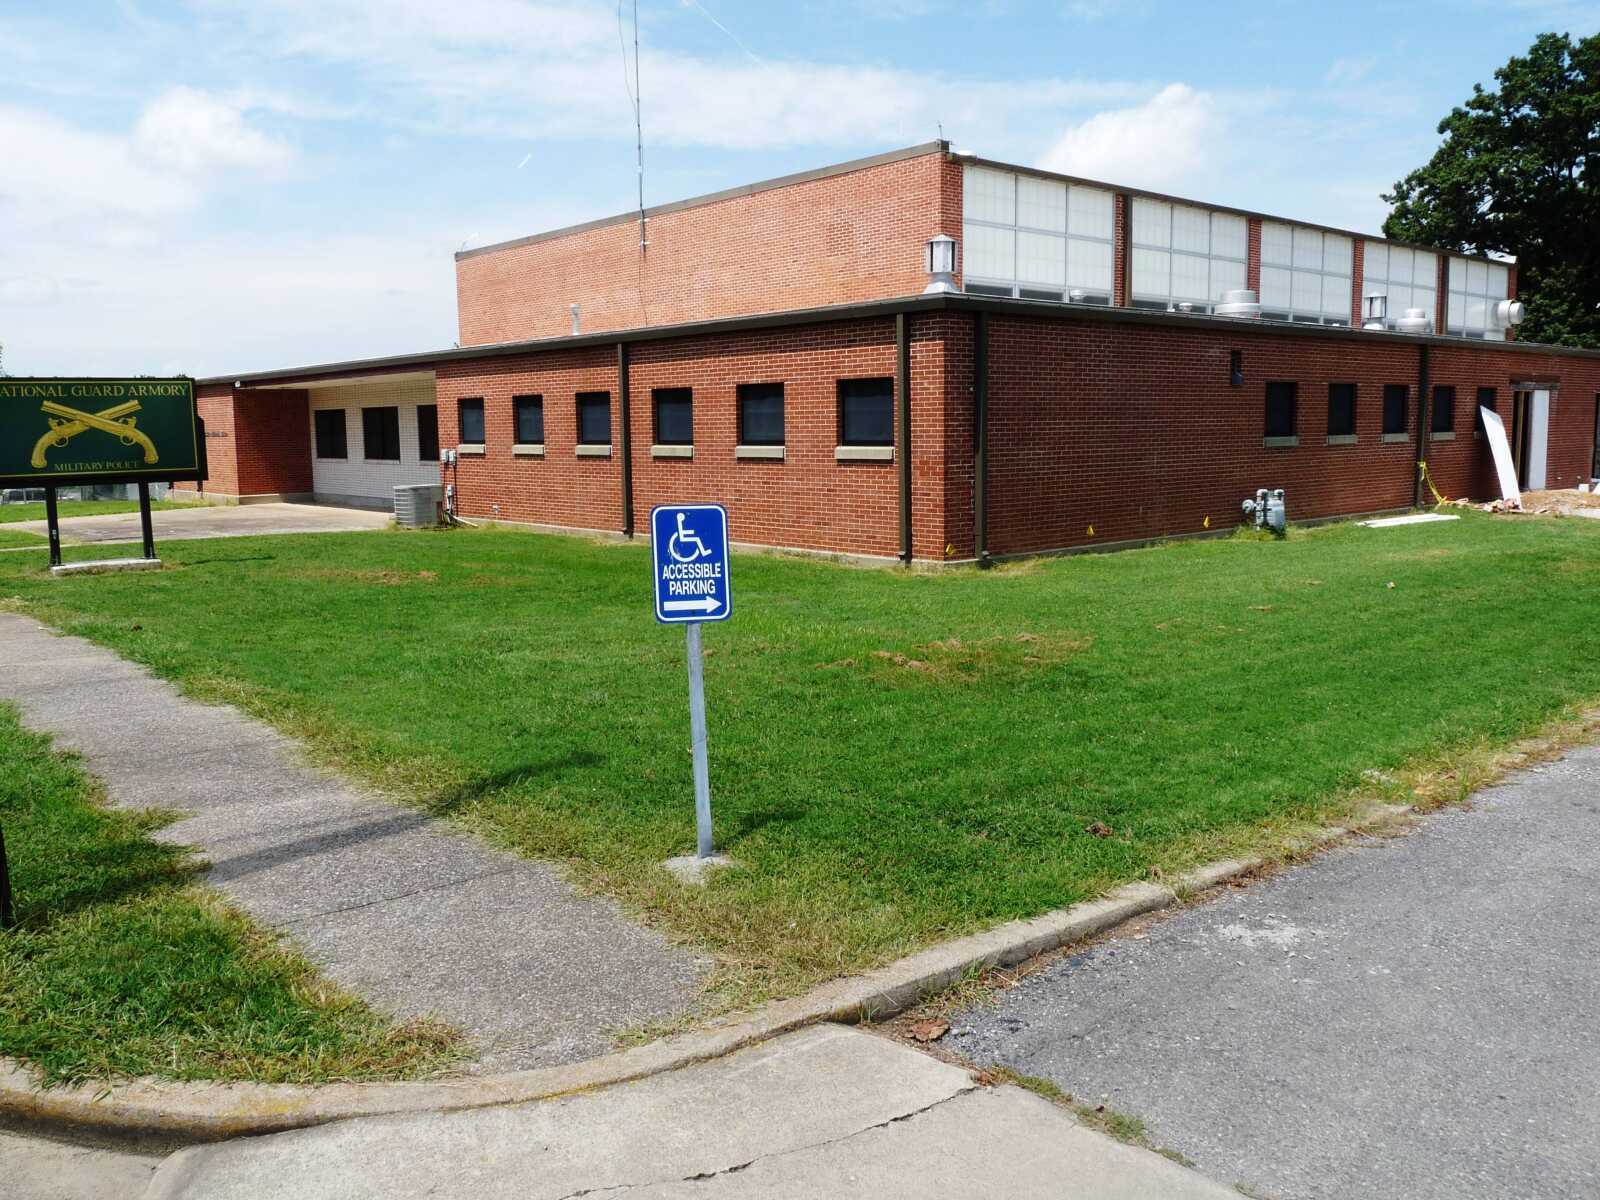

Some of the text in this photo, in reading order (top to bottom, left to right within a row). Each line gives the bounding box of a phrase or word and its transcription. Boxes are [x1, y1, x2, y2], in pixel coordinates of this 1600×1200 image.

[0, 385, 186, 397] ATIONAL GUARD ARMORY
[54, 462, 103, 472] MILITARY
[662, 563, 721, 580] ACCESSIBLE
[669, 580, 715, 596] PARKING
